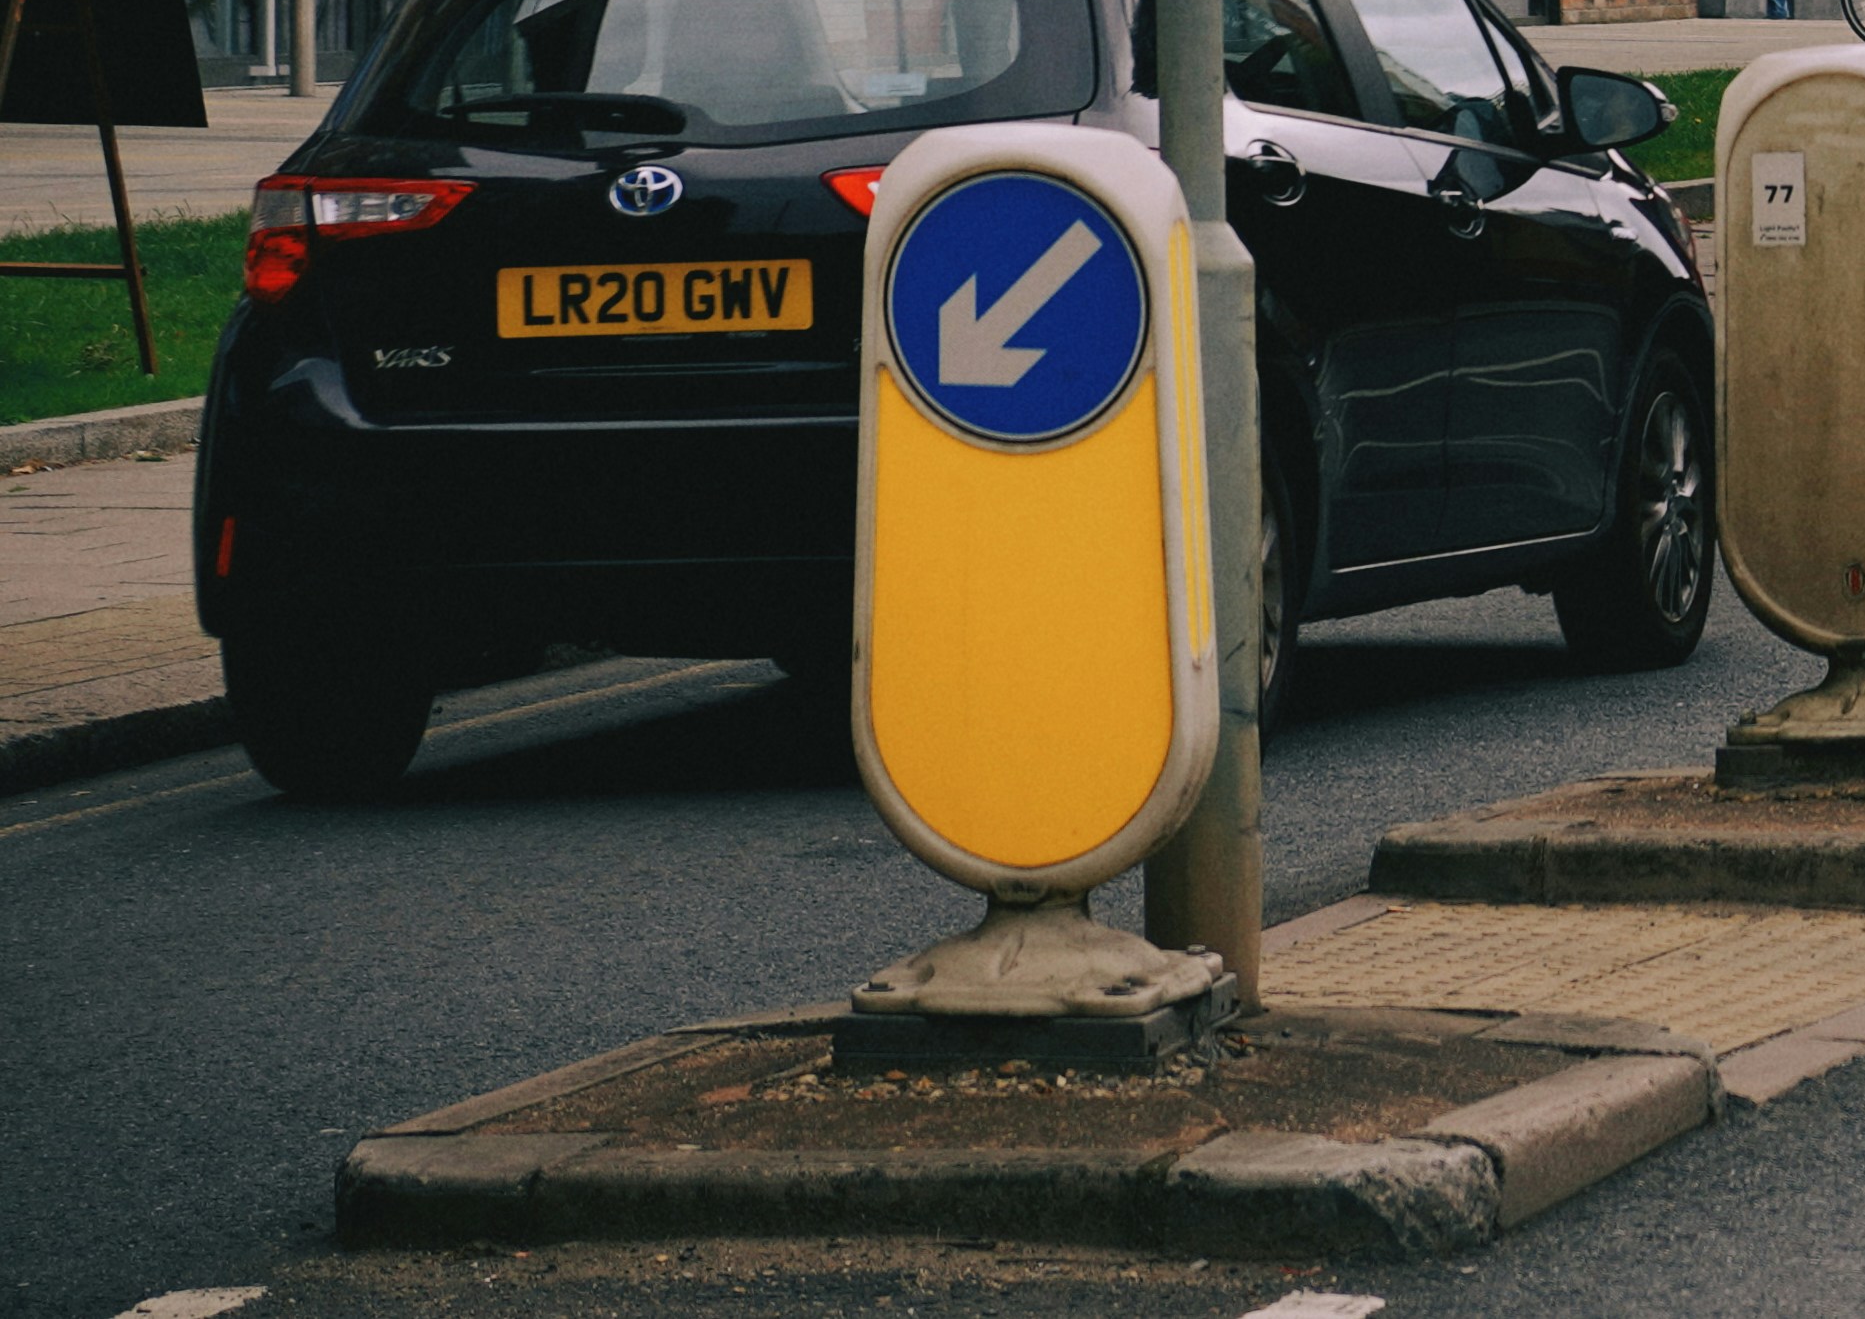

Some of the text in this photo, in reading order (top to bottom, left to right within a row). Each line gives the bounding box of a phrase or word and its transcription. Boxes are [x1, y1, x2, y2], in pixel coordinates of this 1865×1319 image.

[1764, 185, 1793, 203] 77
[523, 268, 790, 326] LR20 GWV
[374, 345, 454, 368] YARIS
